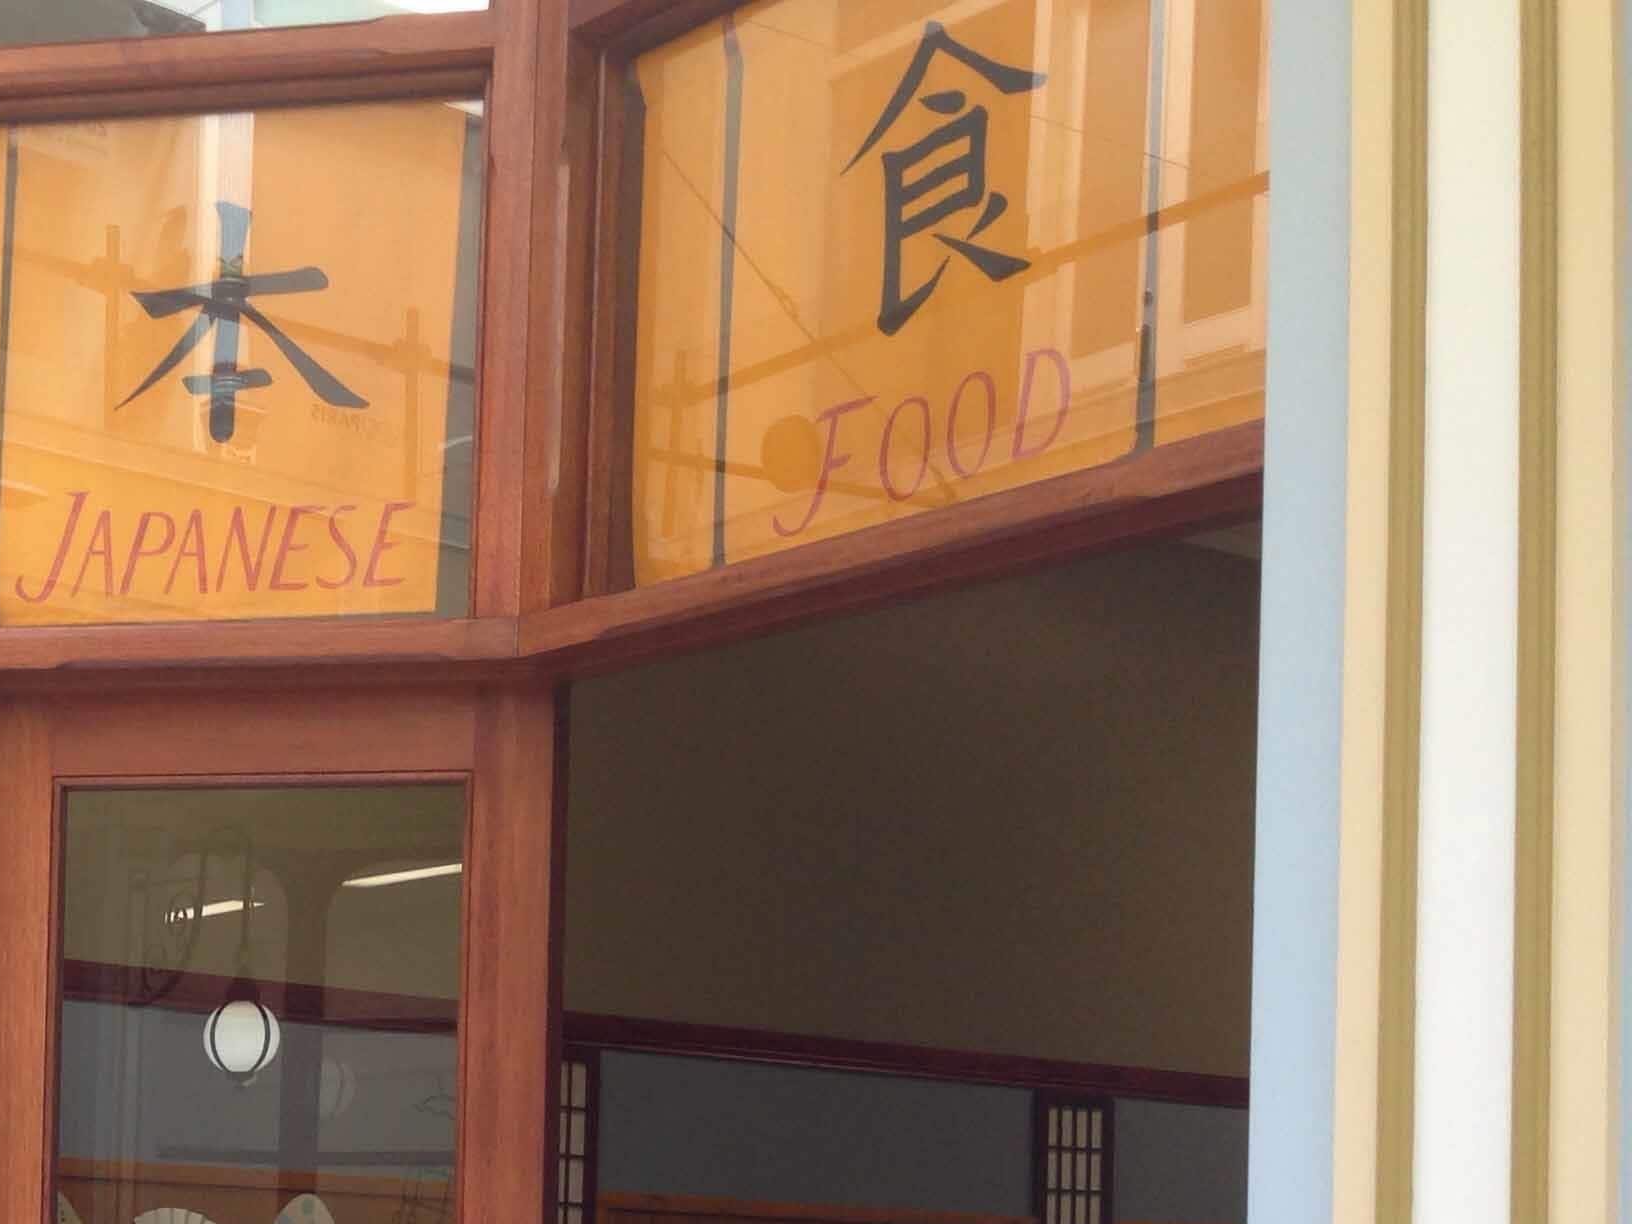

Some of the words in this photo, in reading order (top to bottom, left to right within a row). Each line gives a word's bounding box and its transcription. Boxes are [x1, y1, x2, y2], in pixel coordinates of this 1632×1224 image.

[839, 20, 1048, 337] 食
[772, 348, 1072, 538] FOOD
[14, 490, 418, 603] JAPANESE
